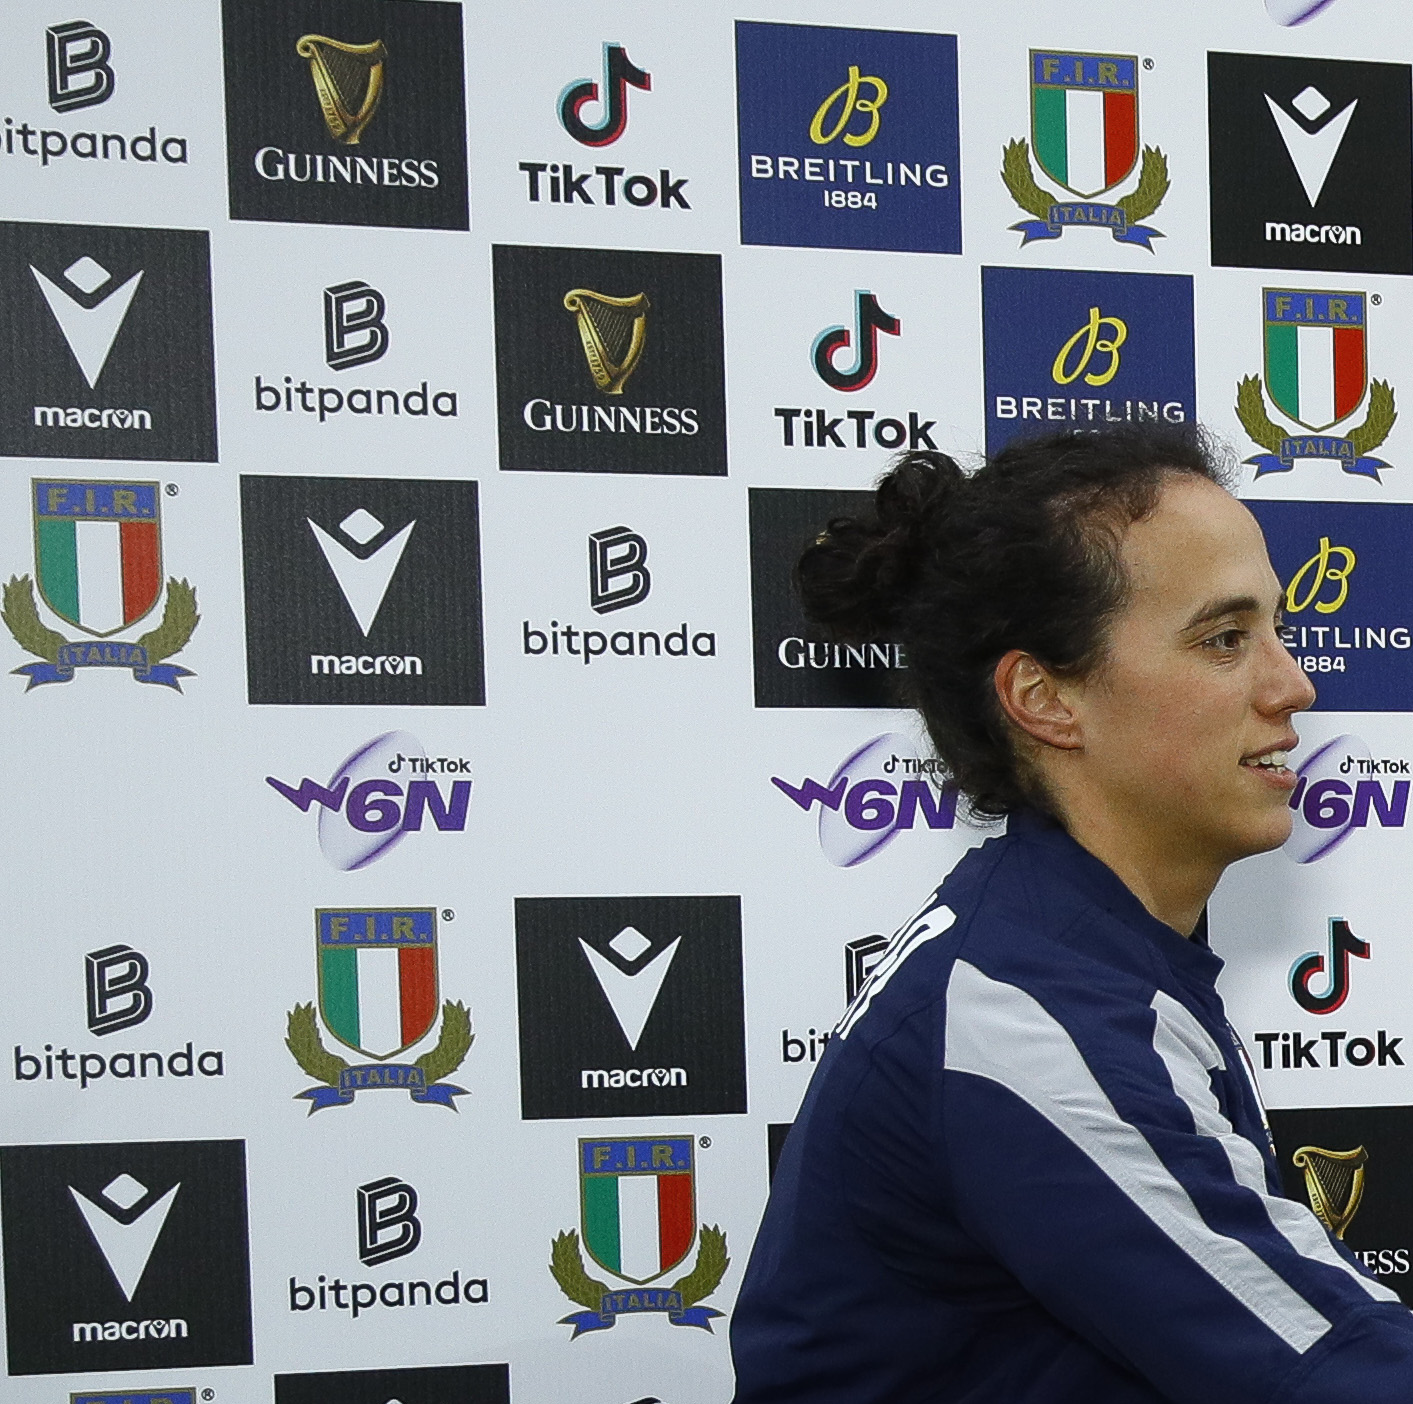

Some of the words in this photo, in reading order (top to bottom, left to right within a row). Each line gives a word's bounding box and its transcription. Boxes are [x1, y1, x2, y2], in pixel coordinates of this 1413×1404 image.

[1043, 59, 1130, 85] F.I.R.
[0, 119, 188, 166] itpanda
[255, 147, 438, 187] GUINNESS
[752, 155, 948, 187] BREITLING
[519, 162, 690, 209] TikTok
[825, 190, 877, 209] 1884
[1050, 205, 1122, 226] ITALIA
[1266, 223, 1361, 244] macron
[1275, 297, 1359, 319] F.I.R.
[256, 376, 457, 422] bitpanda
[996, 396, 1185, 423] BREITLING
[34, 407, 151, 429] macron
[524, 399, 698, 435] GUINNESS
[774, 407, 937, 450] TikTok
[1283, 439, 1352, 458] ITALIA
[47, 490, 151, 514] F.I.R.
[524, 621, 715, 664] bitpanda
[1280, 628, 1411, 649] EITLING
[61, 646, 148, 664] ITALIA
[311, 655, 422, 674] macron
[777, 636, 908, 670] GUINNE
[409, 757, 471, 774] TikTok
[902, 758, 949, 774] TikTo
[1355, 758, 1410, 774] TikTok
[1289, 777, 1411, 828] 6N
[331, 917, 428, 942] F.I.R.
[1255, 1031, 1404, 1069] TikTok
[15, 1042, 223, 1088] bitpanda
[344, 1068, 422, 1086] ITALIA
[582, 1068, 686, 1088] macron
[593, 1145, 684, 1168] F.I.R.
[290, 1271, 488, 1318] bitpanda
[605, 1292, 679, 1311] ITALIA
[73, 1319, 187, 1341] macron
